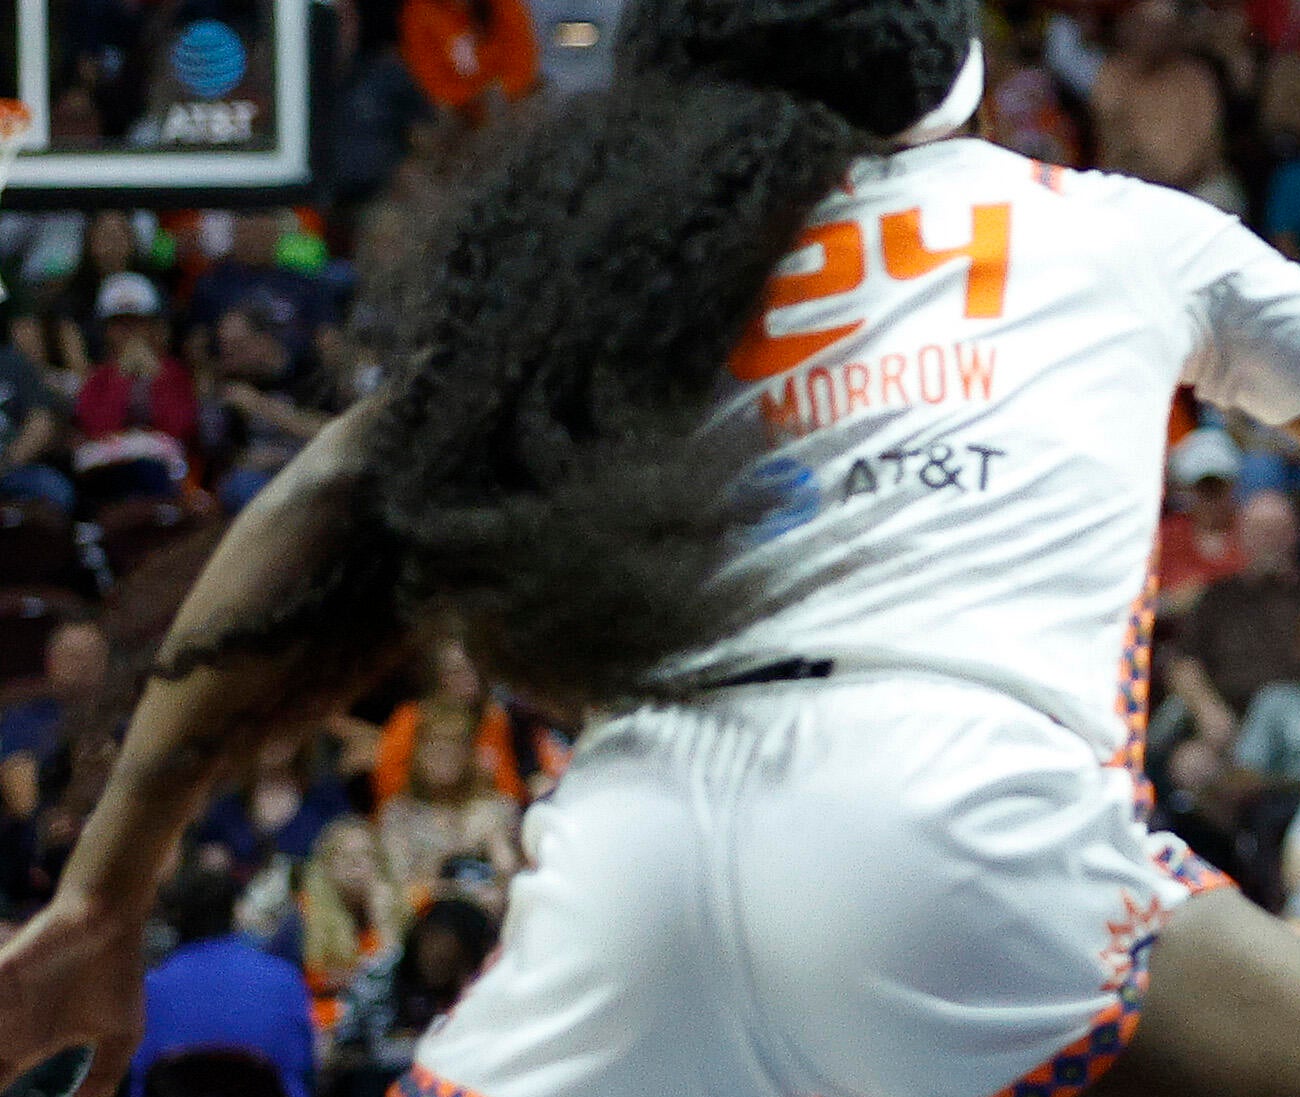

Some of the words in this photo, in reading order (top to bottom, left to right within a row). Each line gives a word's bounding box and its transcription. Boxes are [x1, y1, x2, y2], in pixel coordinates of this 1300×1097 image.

[728, 202, 1012, 382] 24
[758, 342, 997, 448] MORROW
[844, 445, 1006, 502] AT&T
